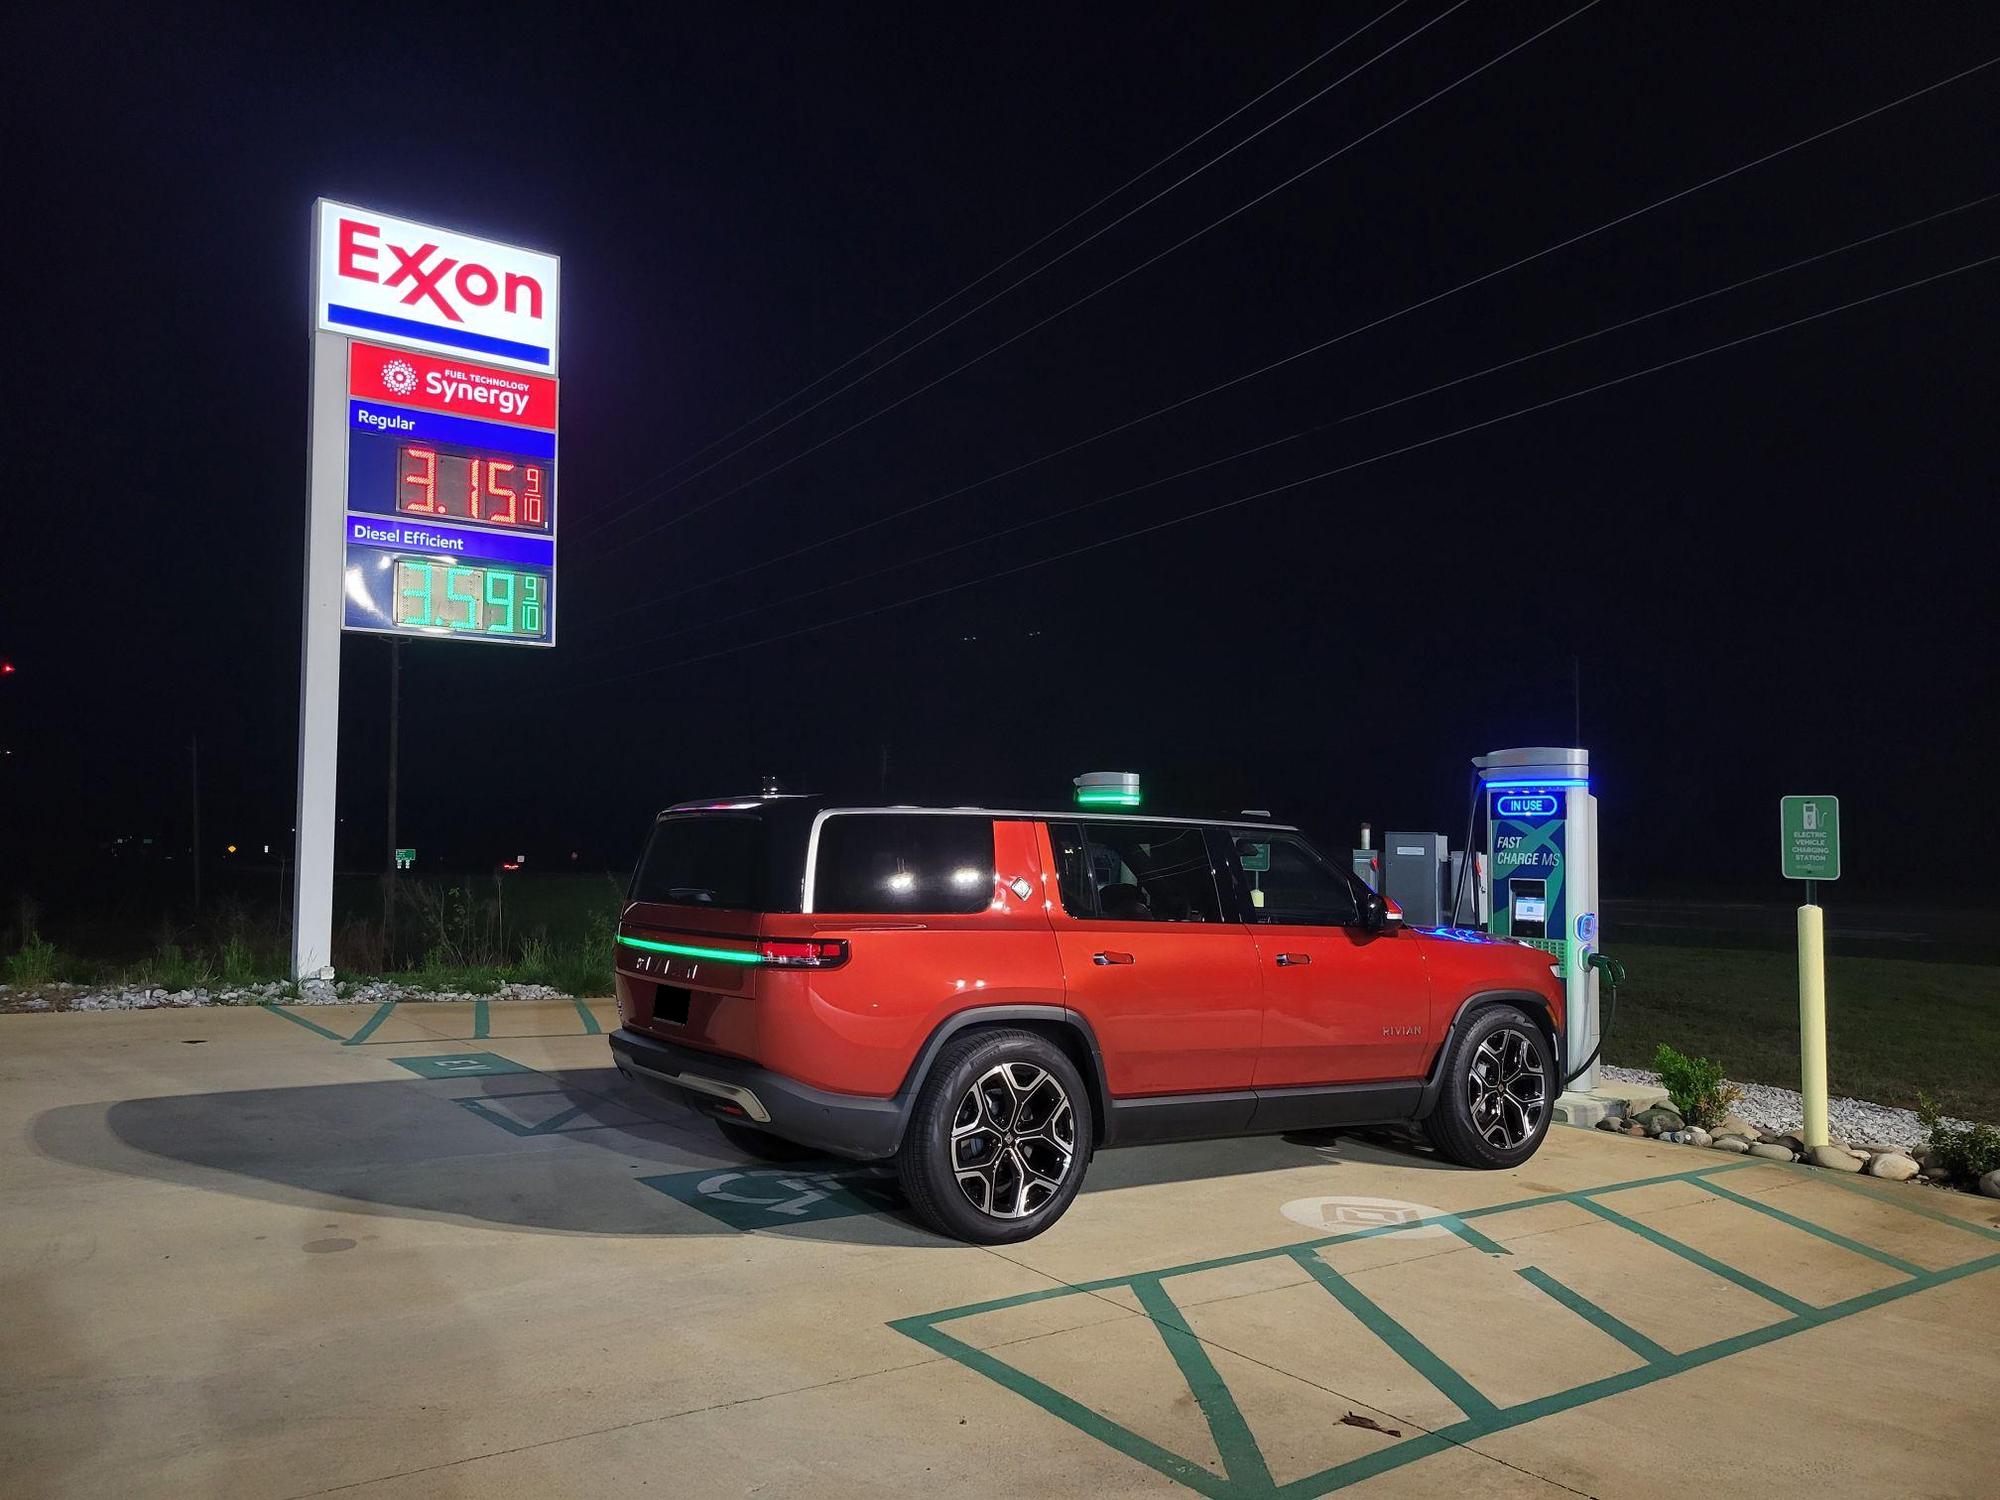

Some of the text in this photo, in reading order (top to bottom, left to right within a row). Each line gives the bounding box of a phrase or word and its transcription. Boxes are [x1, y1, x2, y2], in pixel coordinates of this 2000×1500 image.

[338, 217, 543, 323] Exxon
[444, 369, 530, 392] FUEL TECHNOLOGY
[426, 371, 530, 416] Synergy
[358, 410, 416, 431] Regular
[406, 448, 518, 524] 3.15
[354, 525, 464, 551] Diesel Efficient
[403, 562, 516, 633] 3.59
[1510, 800, 1543, 811] IN USE
[1497, 836, 1522, 849] FAST
[1497, 852, 1561, 867] CHARGE MS
[1382, 1026, 1421, 1036] RIVIAN
